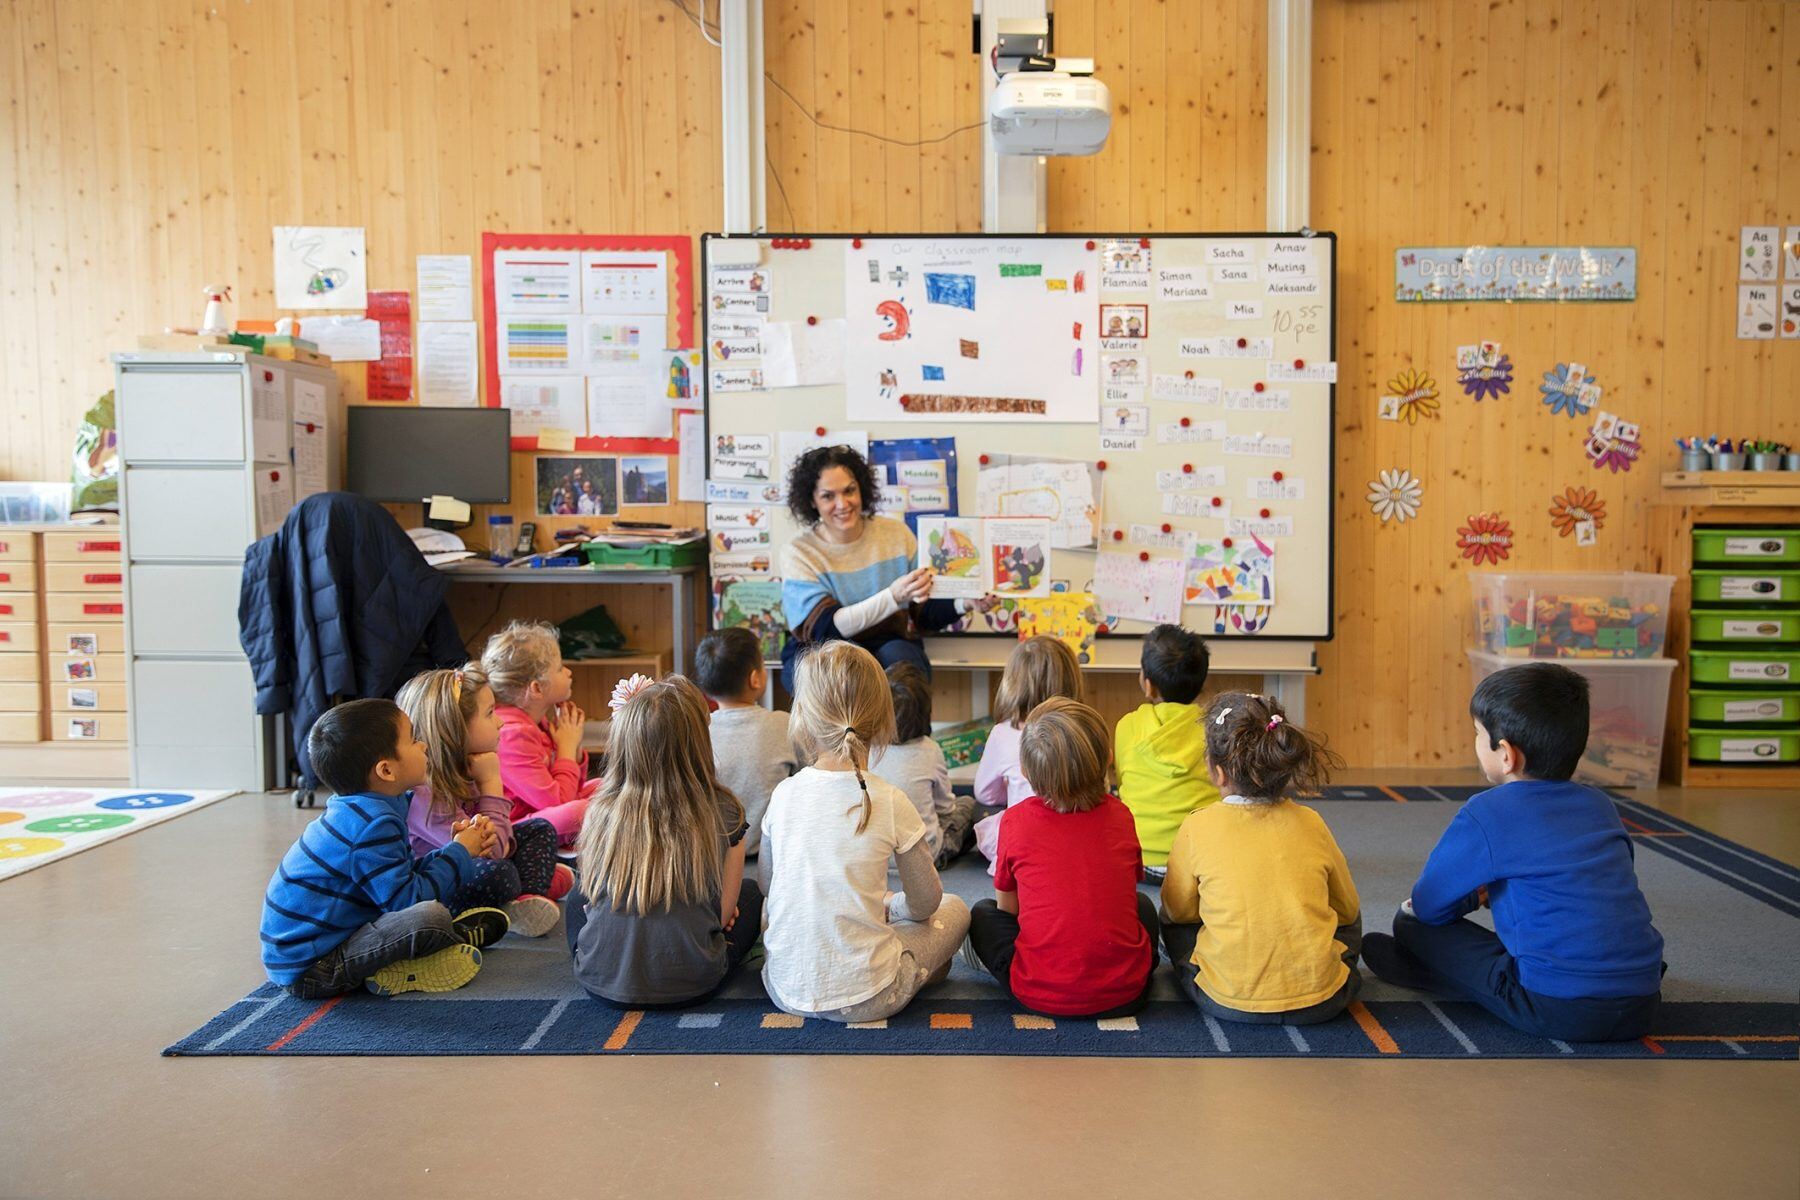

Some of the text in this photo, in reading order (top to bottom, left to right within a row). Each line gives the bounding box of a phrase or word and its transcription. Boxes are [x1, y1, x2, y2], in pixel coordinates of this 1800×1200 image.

[1752, 232, 1768, 241] Aa
[891, 243, 1023, 256] Our classroom map
[1212, 248, 1245, 258] Sacha
[1274, 243, 1307, 253] Arnav
[1267, 263, 1306, 274] Muting
[1418, 258, 1473, 280] Days
[1480, 257, 1505, 277] of
[1511, 257, 1547, 277] the
[1159, 271, 1192, 281] Simon
[1221, 269, 1248, 279] Sana
[1102, 277, 1148, 287] Flaminia
[1163, 287, 1208, 297] Mariana
[1749, 290, 1766, 300] Nn
[1234, 305, 1255, 314] Mia
[1101, 340, 1138, 349] Valerie
[1181, 344, 1210, 354] Noah
[1106, 389, 1128, 399] Ellie
[1102, 439, 1137, 449] Daniel
